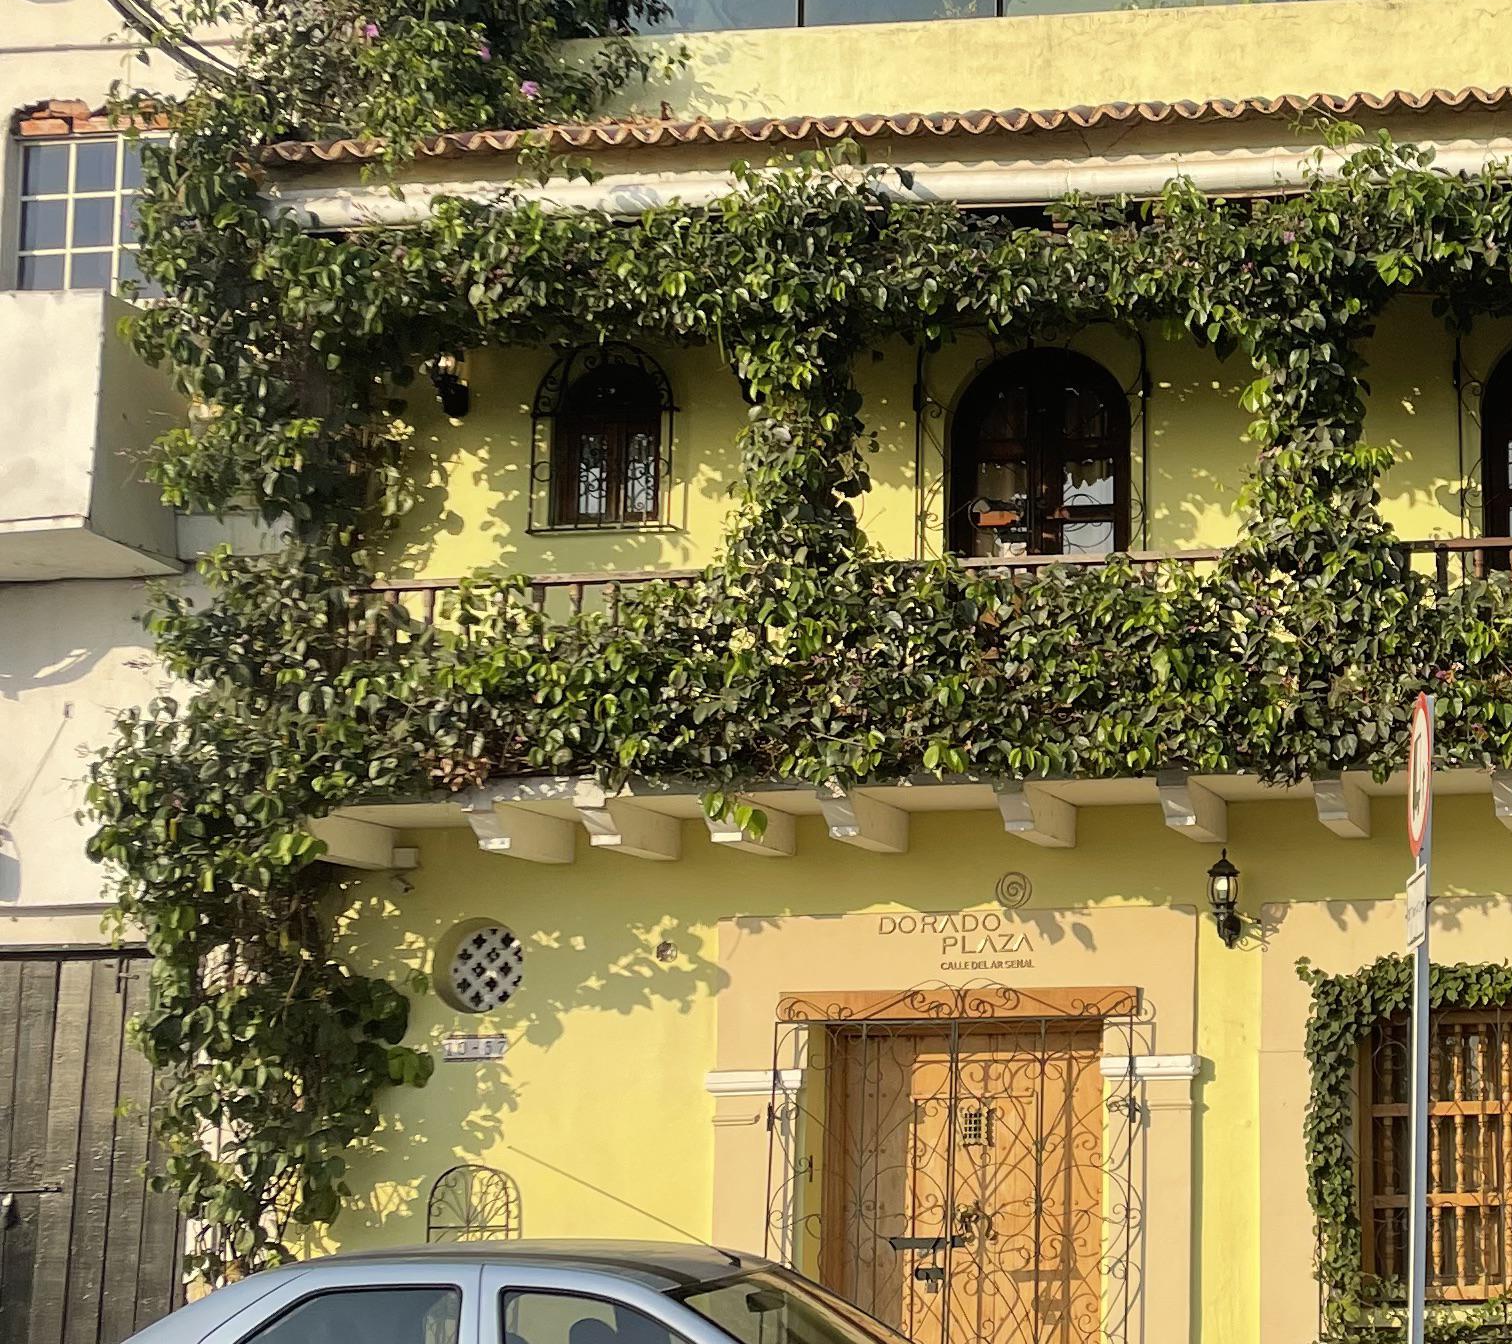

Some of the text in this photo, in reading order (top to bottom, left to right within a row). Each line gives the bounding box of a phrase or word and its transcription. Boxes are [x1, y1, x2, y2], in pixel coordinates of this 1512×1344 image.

[878, 913, 1001, 935] DORADO
[942, 933, 1034, 955] PLAZA
[940, 959, 1035, 971] CALLE DEL ARSENAL
